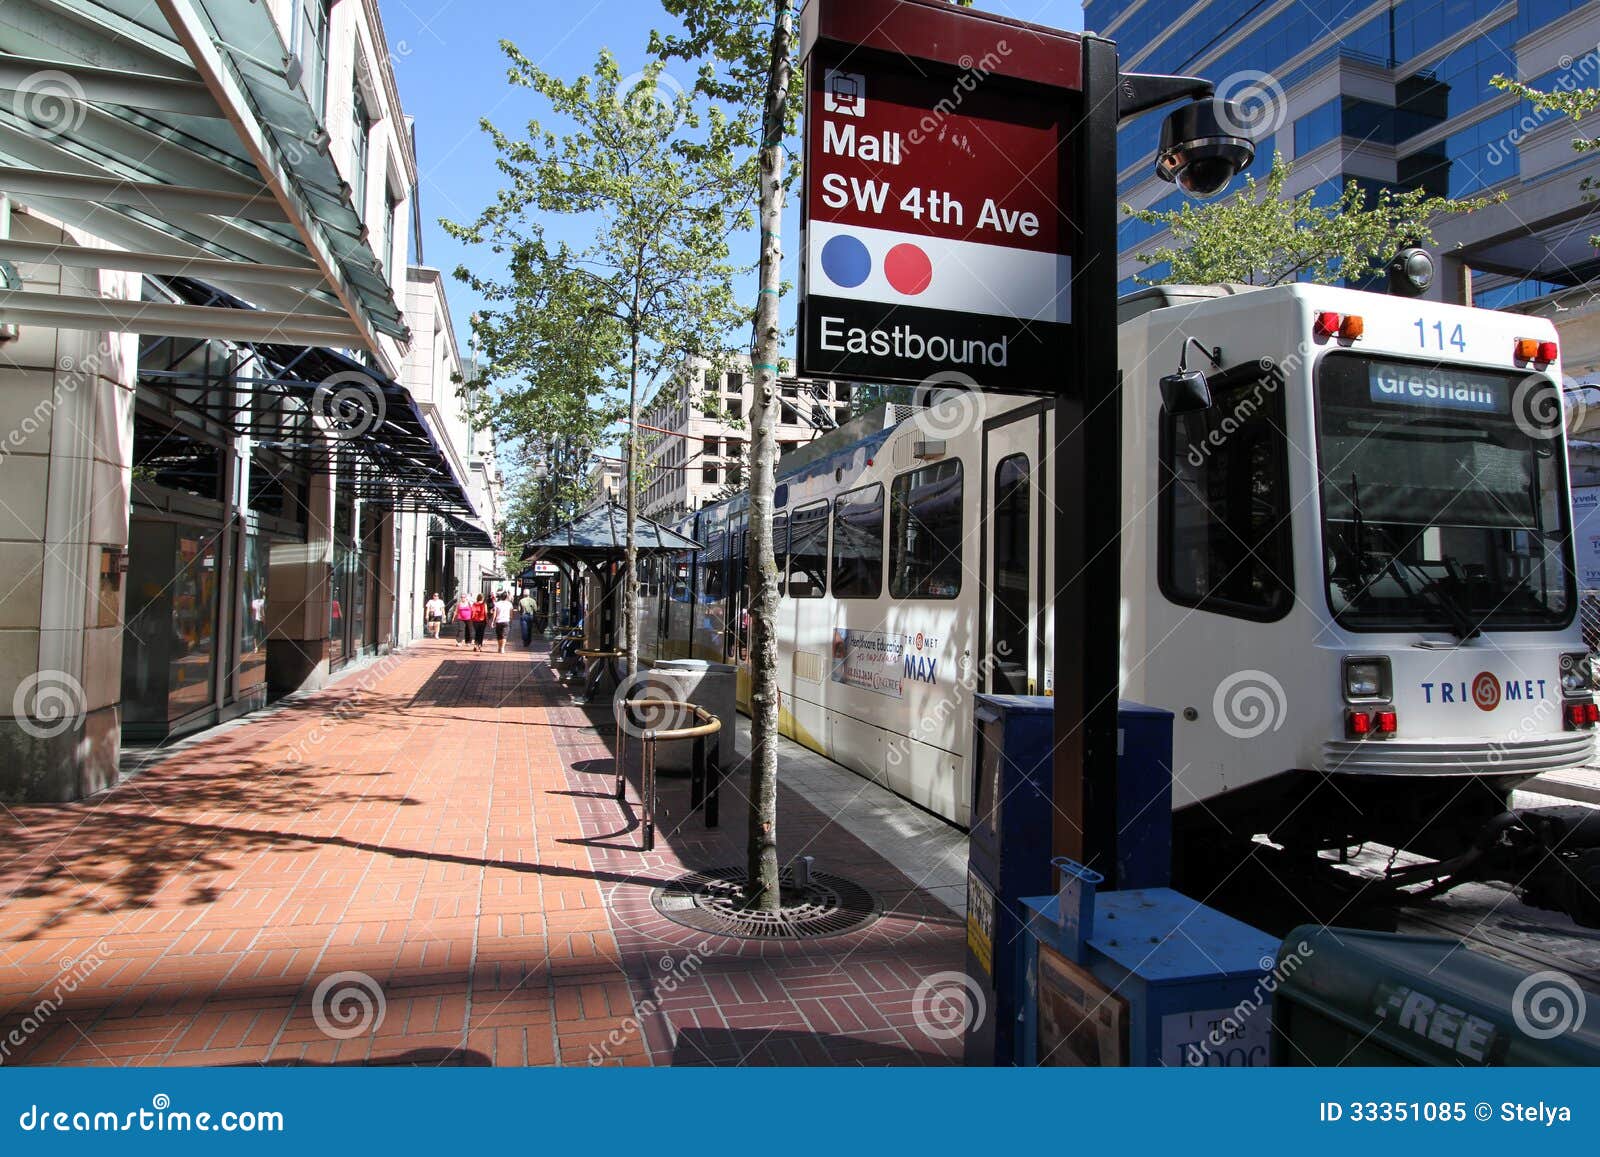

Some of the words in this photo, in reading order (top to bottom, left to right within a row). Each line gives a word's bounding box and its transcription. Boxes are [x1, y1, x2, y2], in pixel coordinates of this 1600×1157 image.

[823, 120, 899, 165] Mall
[822, 173, 890, 214] SW
[900, 187, 963, 226] 4th
[976, 198, 1040, 237] Ave
[820, 316, 1008, 367] Eastbound
[1414, 318, 1466, 353] 114
[1377, 367, 1492, 404] Gresham
[904, 653, 936, 685] MAX
[1421, 682, 1467, 704] TRI
[1505, 679, 1546, 701] MET
